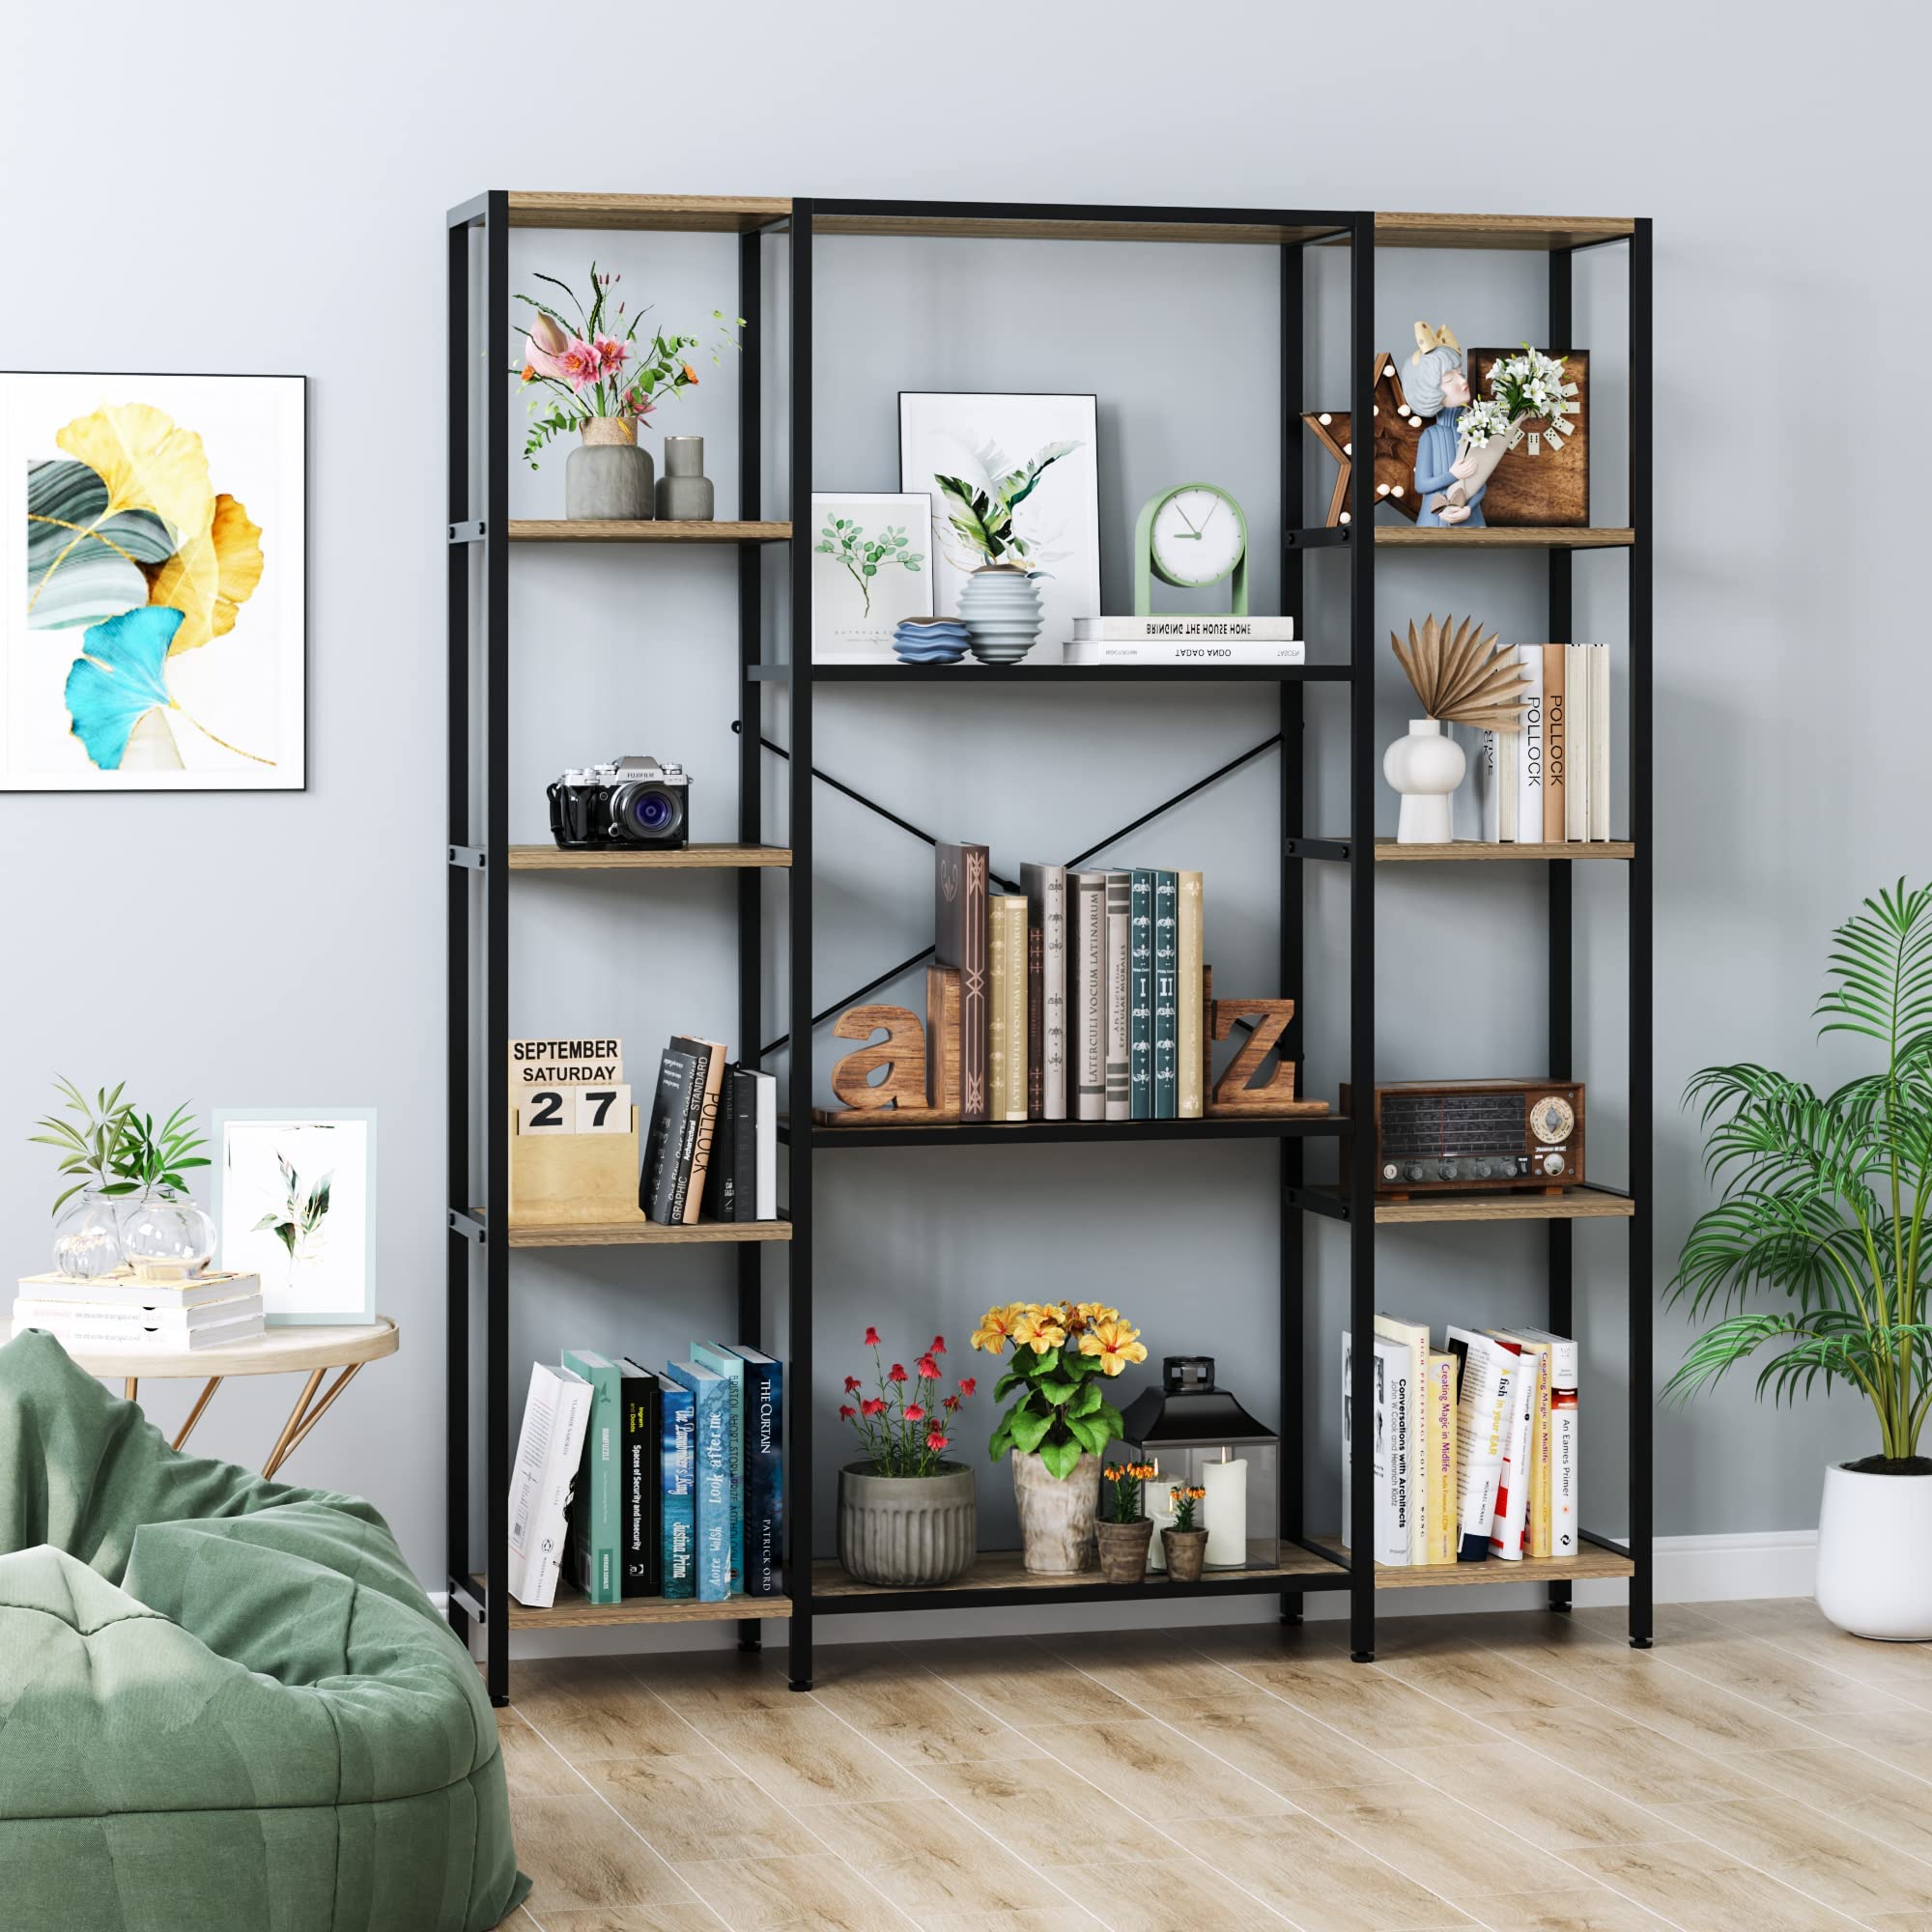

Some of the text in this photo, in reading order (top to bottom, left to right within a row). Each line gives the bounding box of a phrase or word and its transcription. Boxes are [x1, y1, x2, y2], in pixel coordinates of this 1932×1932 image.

[1527, 696, 1541, 787] POLLOCK
[1549, 695, 1563, 786] POLLOCK
[1089, 894, 1098, 1083] LATERCULI VOCUM LATINARUM
[1159, 978, 1173, 997] II
[513, 1039, 618, 1061] SEPTEMBER
[523, 1065, 616, 1082] SATURDAY
[691, 1057, 708, 1111] STANDARD
[529, 1092, 617, 1127] 2 7
[693, 1093, 720, 1174] POLLOCK
[672, 1176, 688, 1220] GRAPHIC
[1439, 1364, 1451, 1401] Creating
[1500, 1368, 1511, 1377] A
[1540, 1352, 1548, 1390] Creating
[1390, 1379, 1399, 1400] John
[1497, 1378, 1510, 1397] fish
[760, 1378, 773, 1455] THE CURTAIN
[1398, 1378, 1406, 1451] Conversations
[1439, 1403, 1451, 1429] Magic
[1491, 1407, 1504, 1433] your
[1540, 1392, 1548, 1418] Magic
[1562, 1419, 1570, 1432] An
[631, 1444, 641, 1468] Spaces
[706, 1410, 724, 1504] Look after me
[1441, 1442, 1450, 1472] Midlife
[1489, 1434, 1500, 1456] EAR
[631, 1476, 641, 1504] Security
[1398, 1477, 1406, 1528] Architects
[632, 1504, 641, 1517] and
[631, 1517, 641, 1550] Insecurity
[762, 1519, 771, 1592] PATRICK ORD
